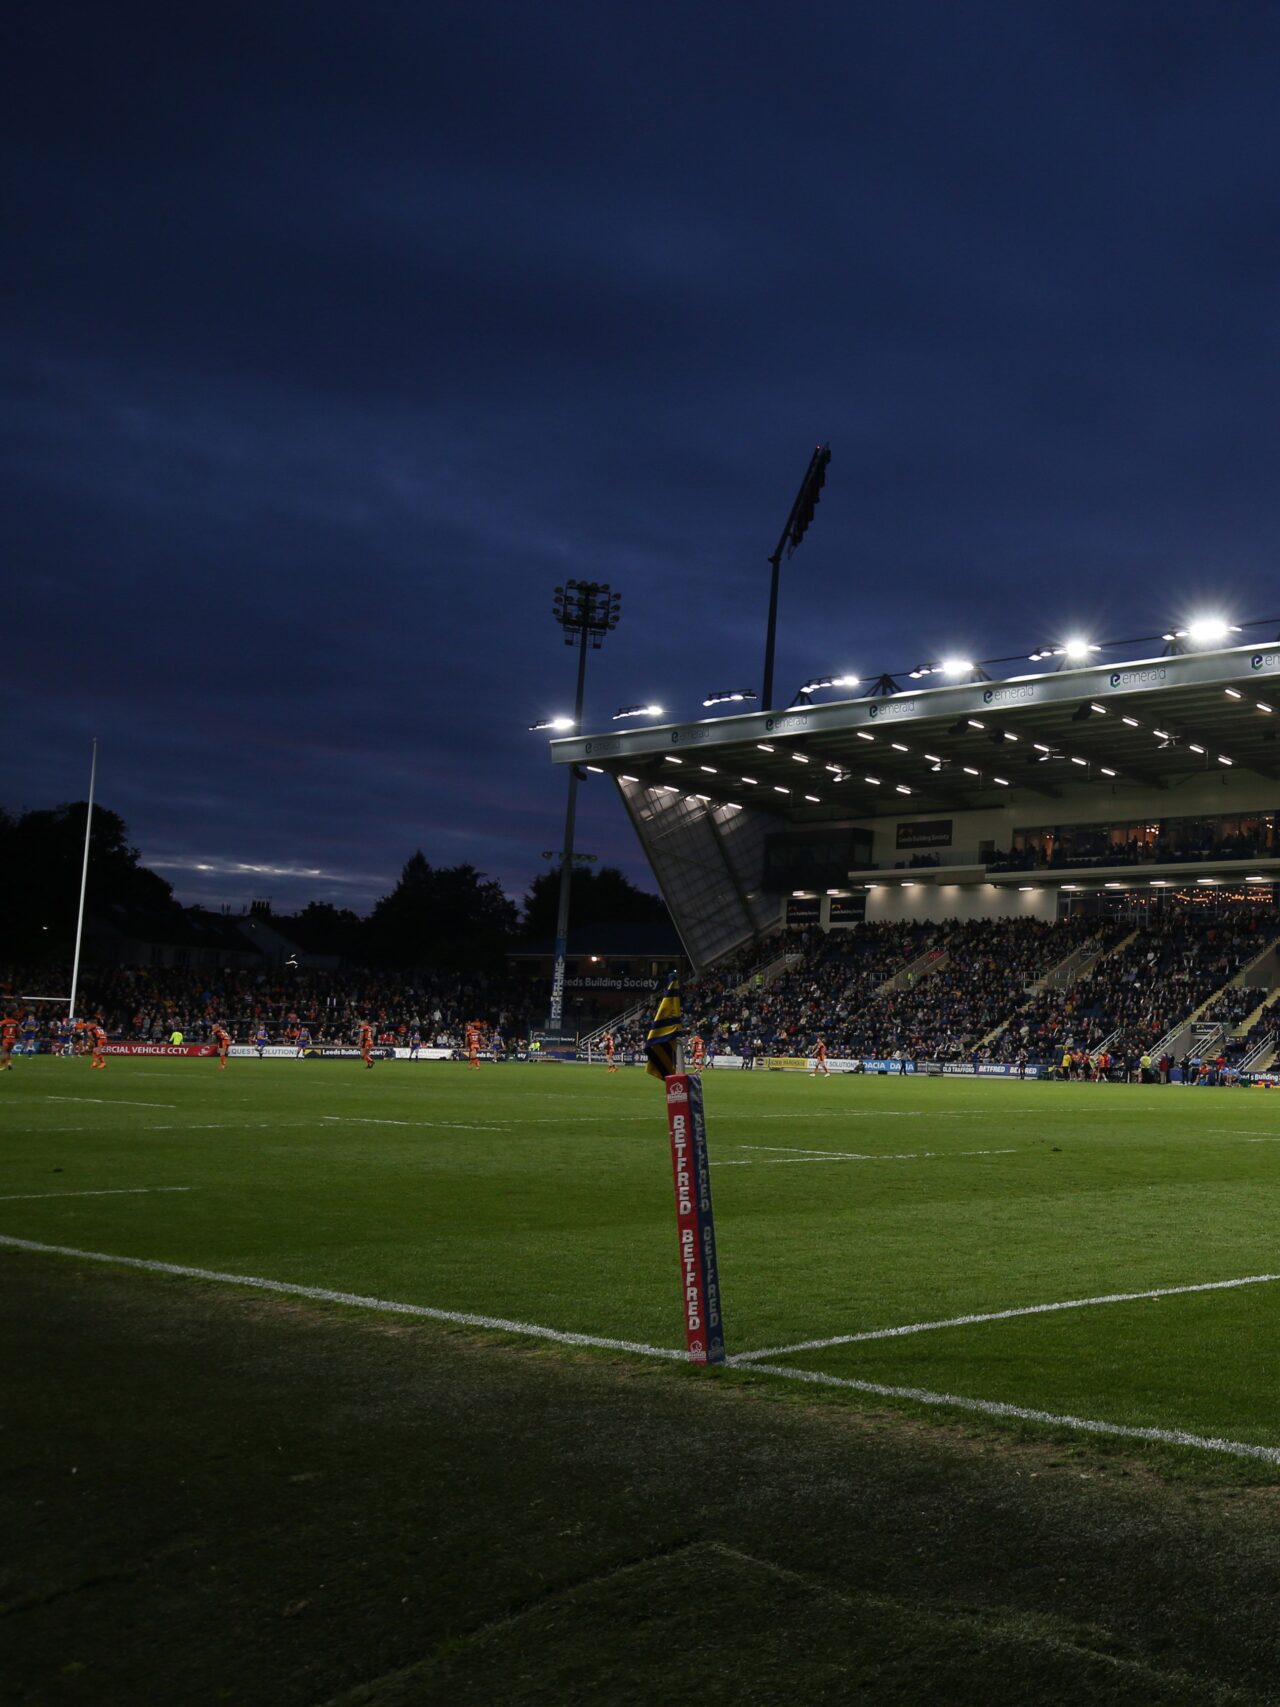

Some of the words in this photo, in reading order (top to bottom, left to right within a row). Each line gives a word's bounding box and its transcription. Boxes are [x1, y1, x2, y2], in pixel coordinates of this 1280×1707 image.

[1121, 666, 1166, 685] emerald
[994, 684, 1034, 701] emerald
[878, 700, 915, 715] emerald
[774, 715, 808, 729] emerald
[563, 977, 584, 987] eeds
[584, 976, 622, 989] Building
[623, 977, 659, 990] Society
[101, 1046, 129, 1054] ERCIAL
[132, 1046, 166, 1054] VEHICLE
[167, 1046, 189, 1055] CCTV
[366, 1049, 387, 1057] ociety
[1254, 1072, 1279, 1082] Building
[672, 1114, 692, 1216] BETFRED
[682, 1228, 700, 1330] BETFRED
[703, 1225, 719, 1328] BETFRED
